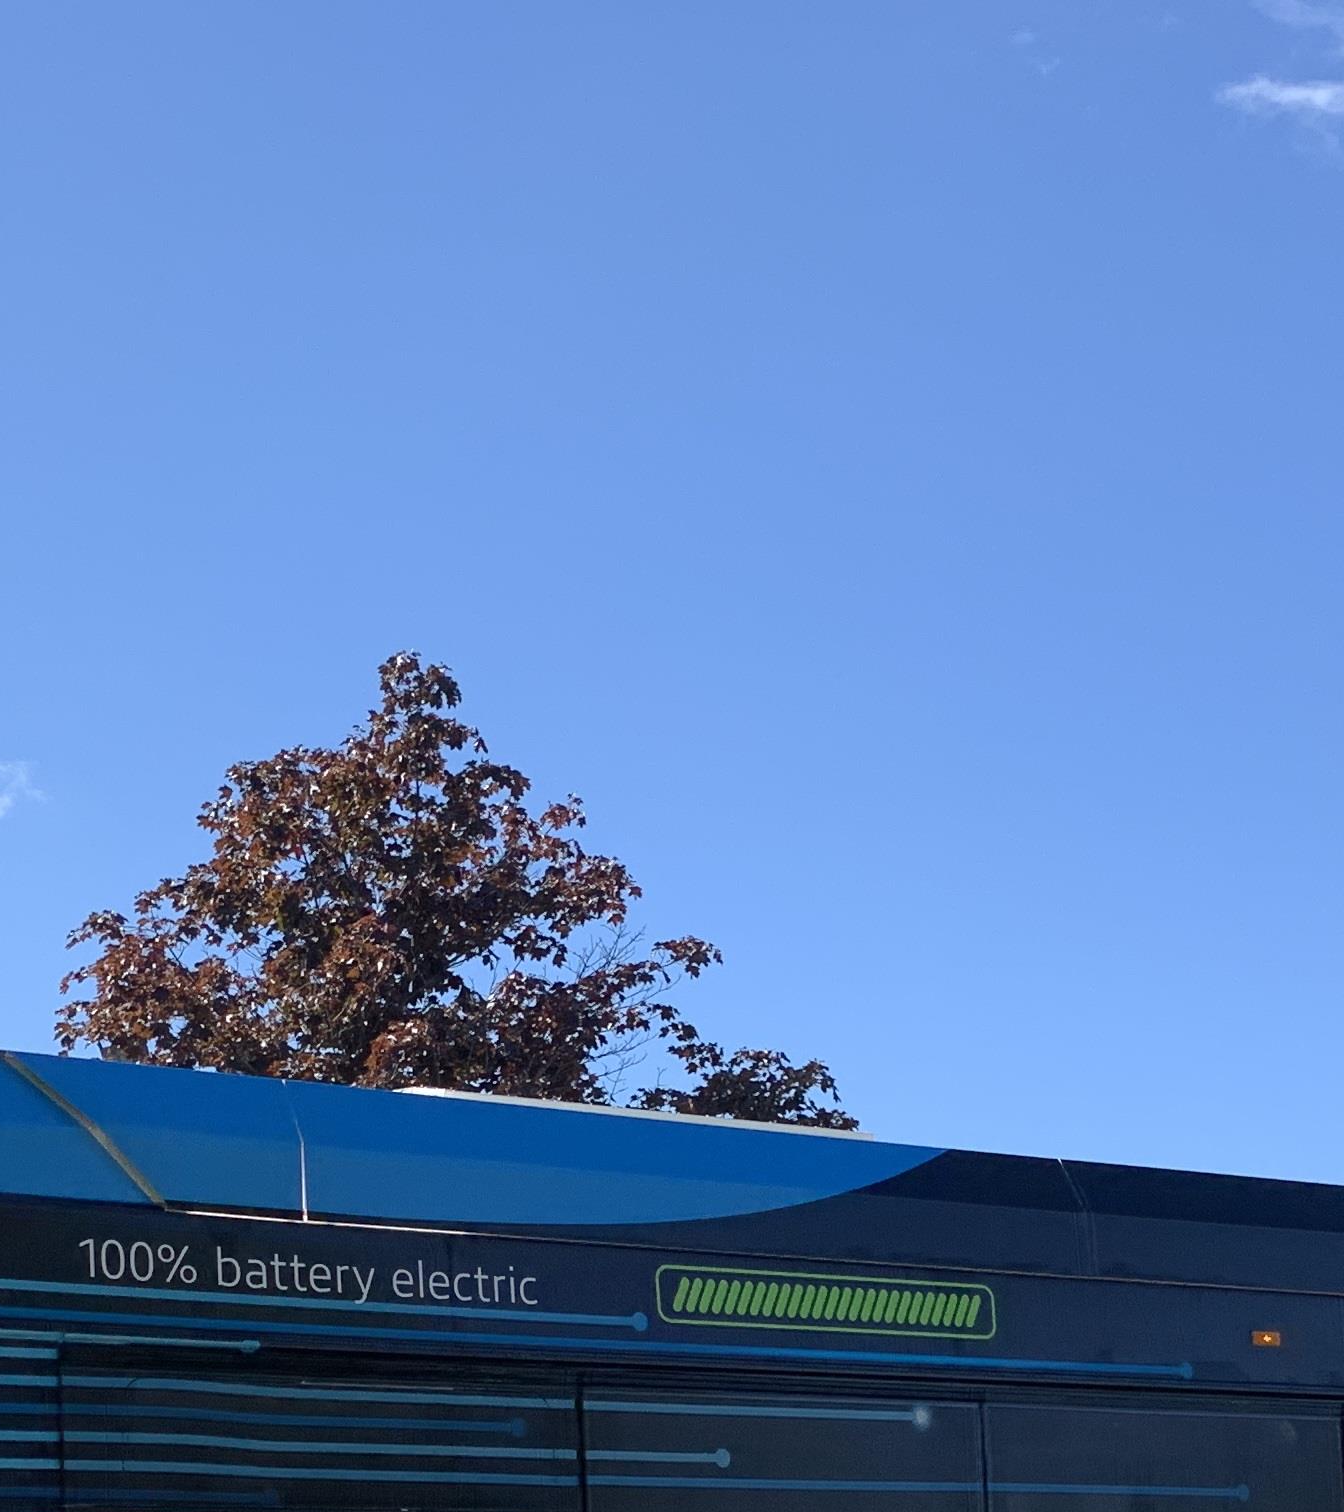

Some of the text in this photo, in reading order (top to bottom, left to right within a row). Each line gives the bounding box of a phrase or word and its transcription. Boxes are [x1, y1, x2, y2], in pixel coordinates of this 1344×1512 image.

[78, 1238, 539, 1305] 100% battery electric
